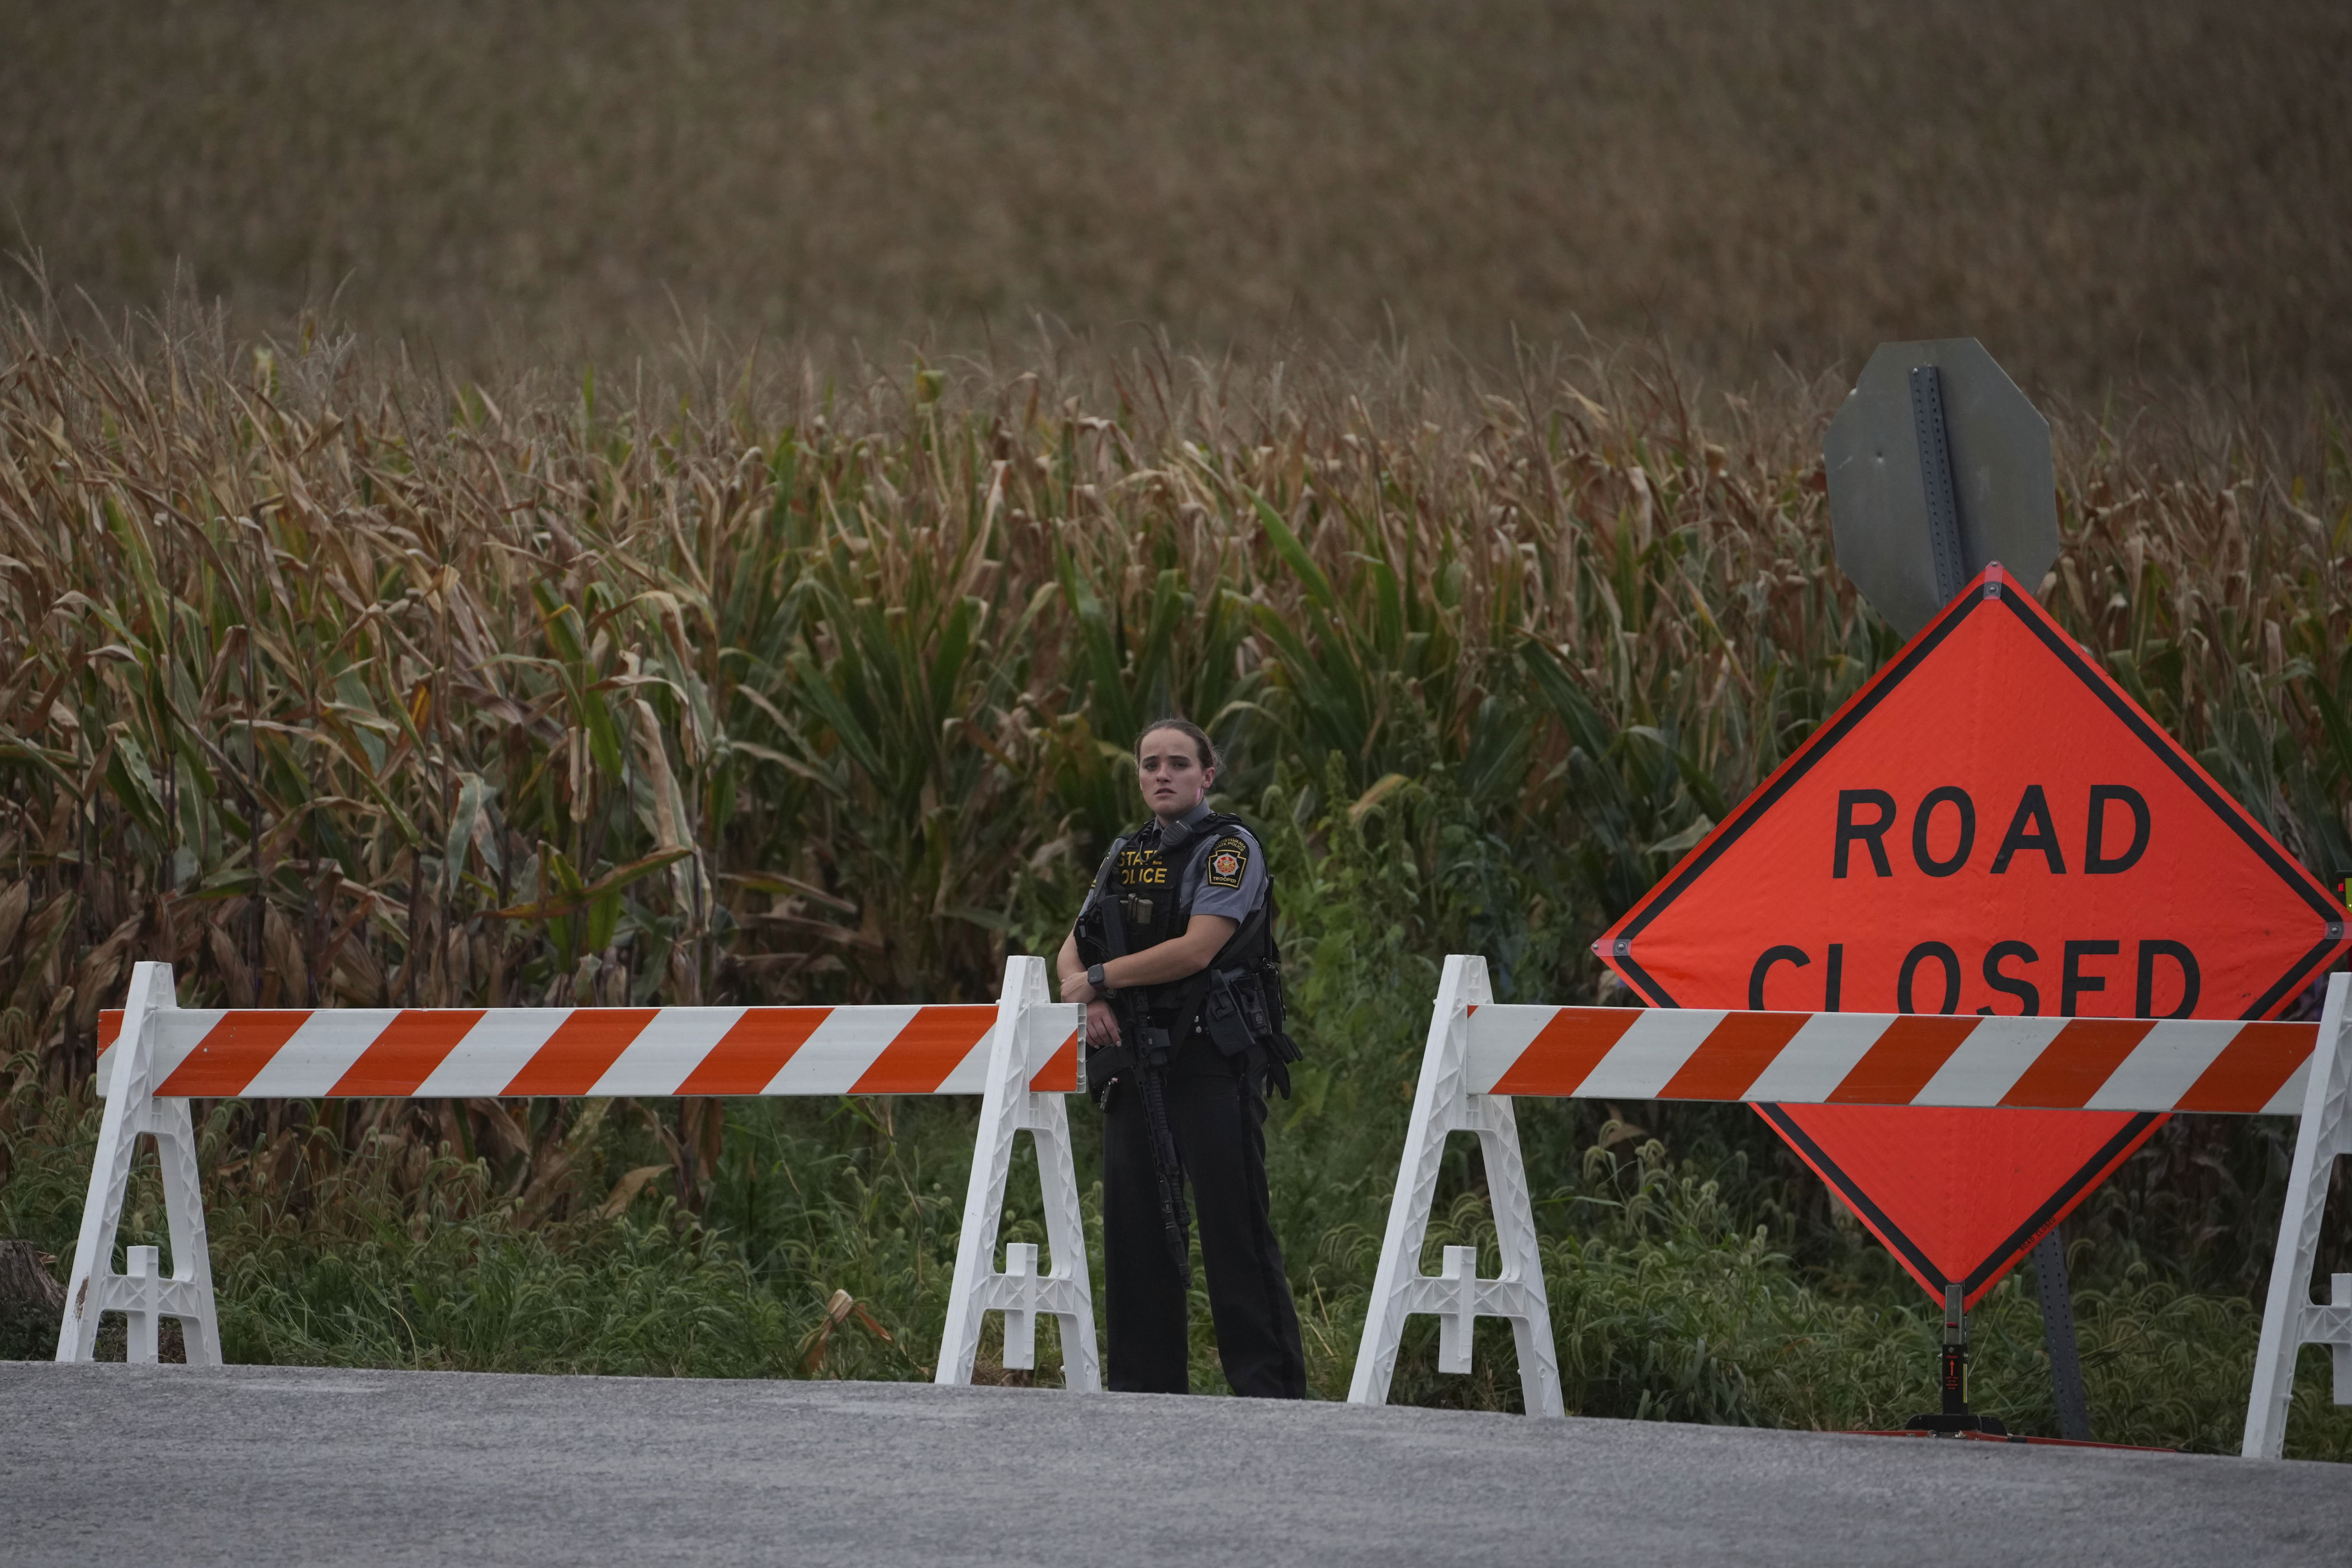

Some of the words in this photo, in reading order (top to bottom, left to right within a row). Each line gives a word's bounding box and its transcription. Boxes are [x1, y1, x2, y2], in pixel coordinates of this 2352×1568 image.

[1228, 841, 1244, 852] POLICE
[1832, 784, 2151, 879] ROAD
[1121, 868, 1168, 885] OLICE
[1748, 940, 2201, 1020] CLOSED
[2020, 1237, 2035, 1252] ROAD
[2036, 1216, 2057, 1237] CLOSED
